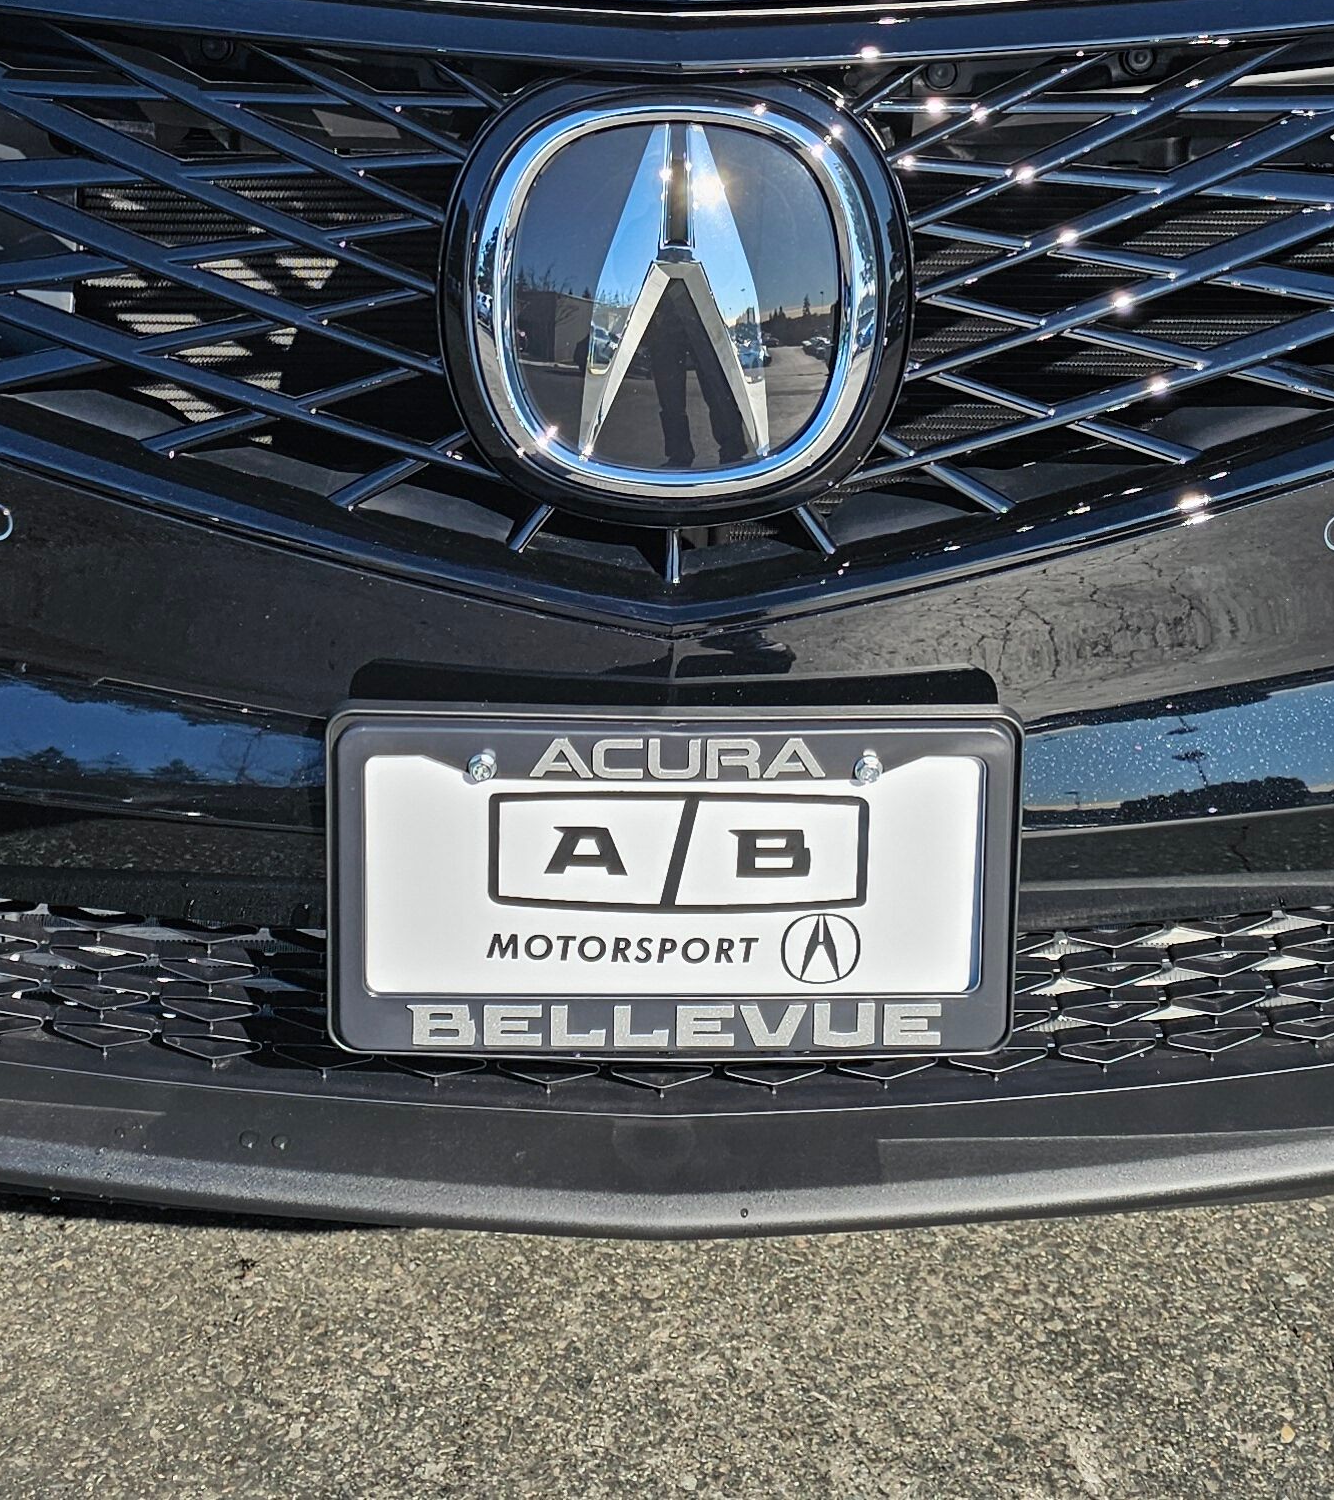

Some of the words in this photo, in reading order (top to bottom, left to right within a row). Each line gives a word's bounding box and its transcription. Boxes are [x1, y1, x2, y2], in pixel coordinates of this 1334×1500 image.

[529, 737, 826, 781] ACURA
[486, 932, 760, 966] MOTORSPORT
[405, 1002, 943, 1048] BELLEVUE
